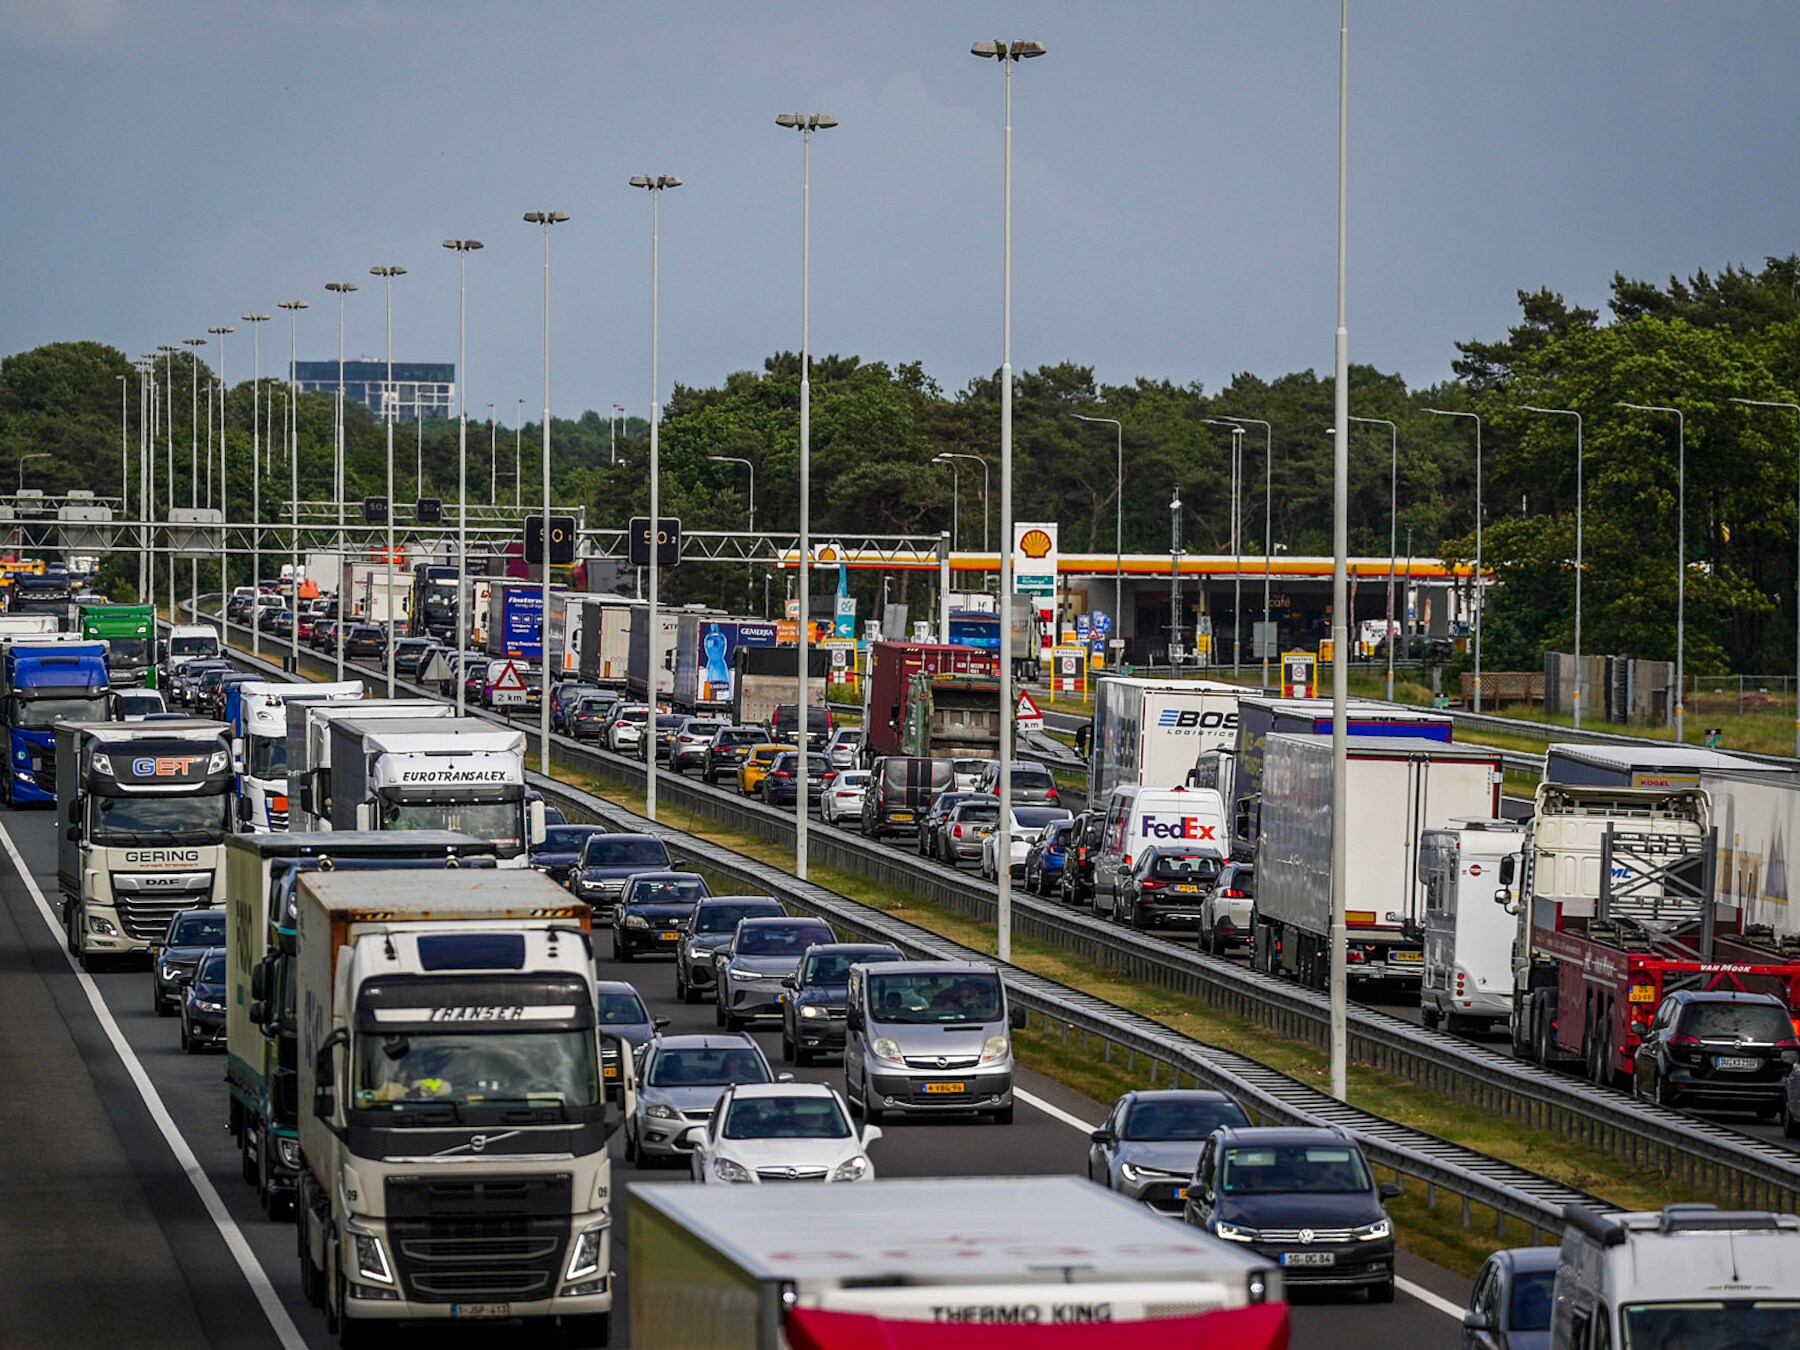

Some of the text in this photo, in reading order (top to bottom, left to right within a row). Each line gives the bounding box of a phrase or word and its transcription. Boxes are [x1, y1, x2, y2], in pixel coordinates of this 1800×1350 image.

[497, 694, 522, 702] 2 km
[1024, 721, 1039, 729] km
[1176, 711, 1239, 729] BOS
[1167, 729, 1235, 737] LOGISTICS
[133, 757, 195, 776] GET
[402, 770, 506, 782] EUROTRANSALEX
[1141, 815, 1216, 840] FedEx
[125, 850, 199, 862] GERING
[145, 878, 180, 886] DAF
[1700, 964, 1718, 972] VAN
[431, 1006, 525, 1021] TRANSER
[930, 1302, 1112, 1323] THERMO KING
